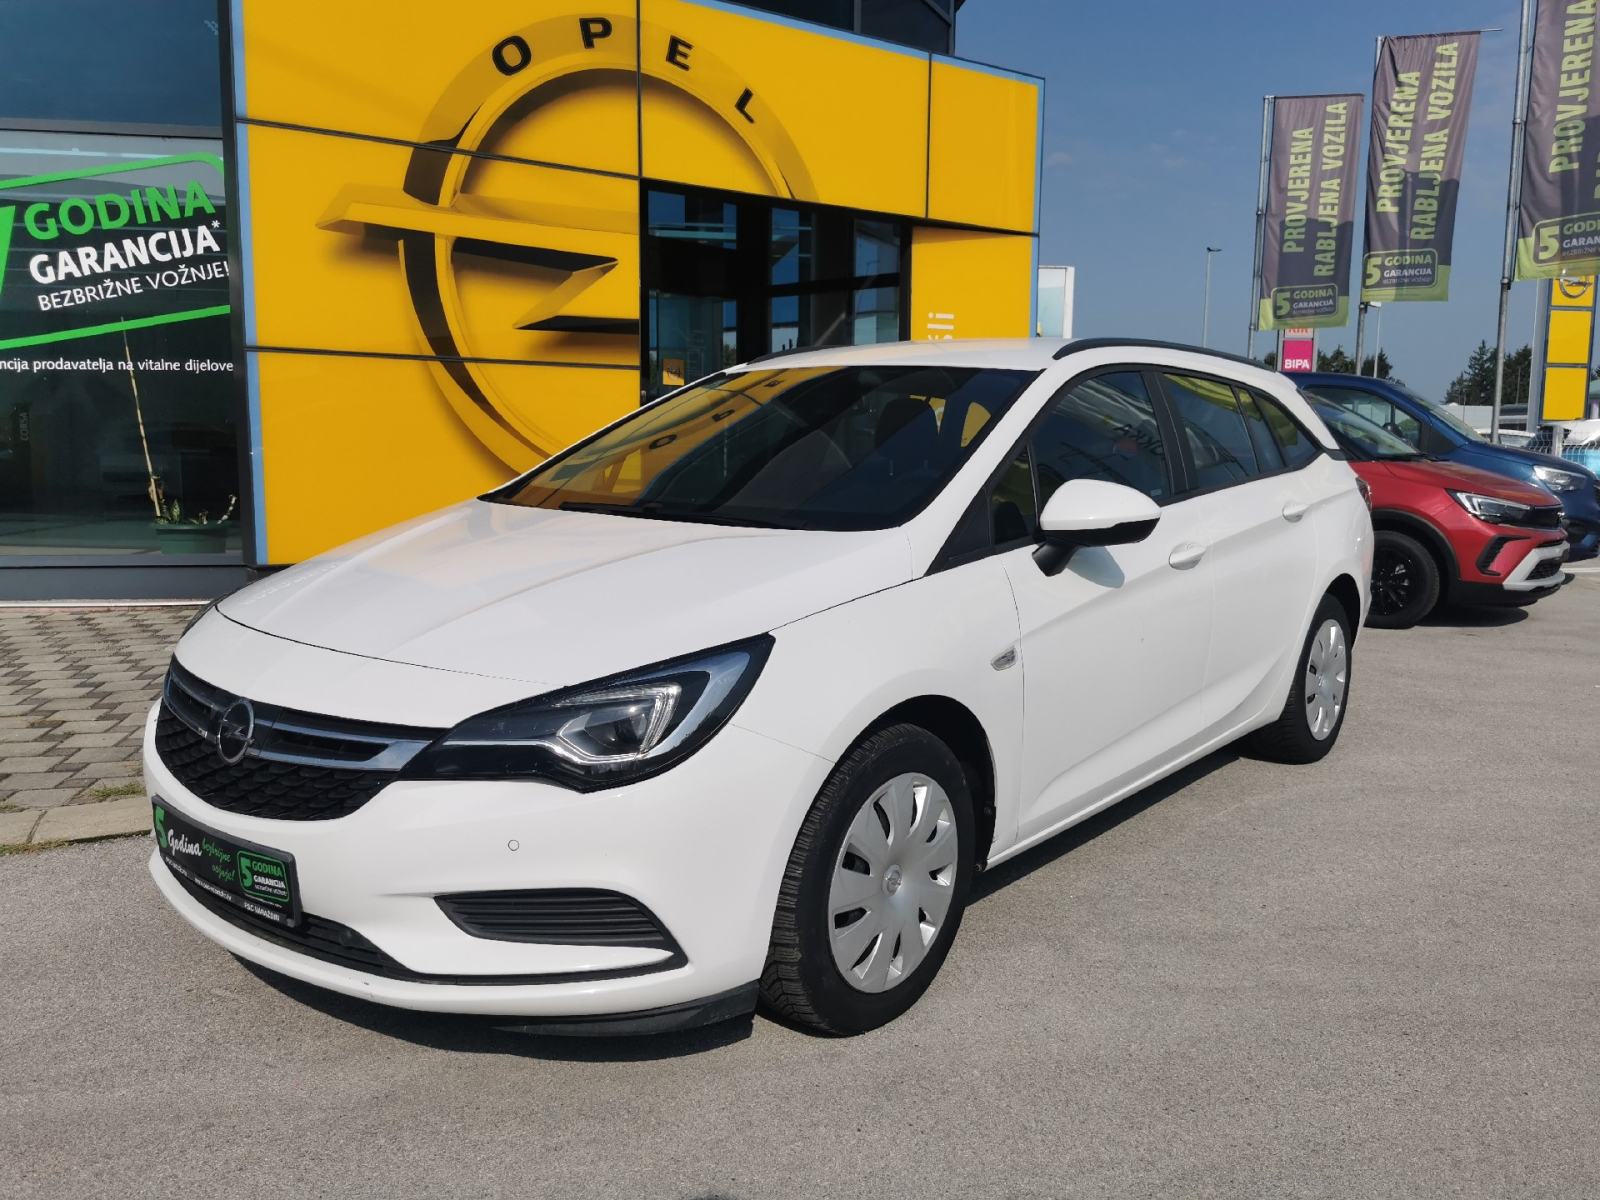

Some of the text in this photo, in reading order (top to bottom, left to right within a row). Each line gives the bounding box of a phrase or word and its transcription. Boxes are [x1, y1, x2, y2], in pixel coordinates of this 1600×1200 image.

[492, 17, 755, 124] OPEL
[1322, 102, 1348, 171] VOZILA
[1376, 71, 1421, 214] PROVJERENA
[1410, 41, 1458, 240] RABLJENA VOZILA
[1283, 127, 1314, 253] PROVJERENA
[24, 180, 216, 240] GODINA
[1313, 178, 1341, 277] RABLJENA
[1538, 225, 1560, 260] 5
[1365, 256, 1382, 286] 5
[1383, 267, 1433, 278] GARANCIJA
[1384, 254, 1433, 266] GODINA
[38, 277, 144, 311] BEZBRIŽNE
[1276, 291, 1291, 316] 5
[1292, 298, 1334, 309] GARANCIJA
[1293, 288, 1334, 299] GODINA
[33, 357, 114, 374] prodavatelja
[118, 360, 134, 370] na
[138, 358, 181, 371] vitalne
[185, 358, 234, 373] dijelove
[1284, 359, 1310, 369] BIPA
[155, 806, 168, 848] 5
[167, 828, 202, 857] Godina
[240, 857, 253, 889] 5
[252, 860, 283, 877] GODINA
